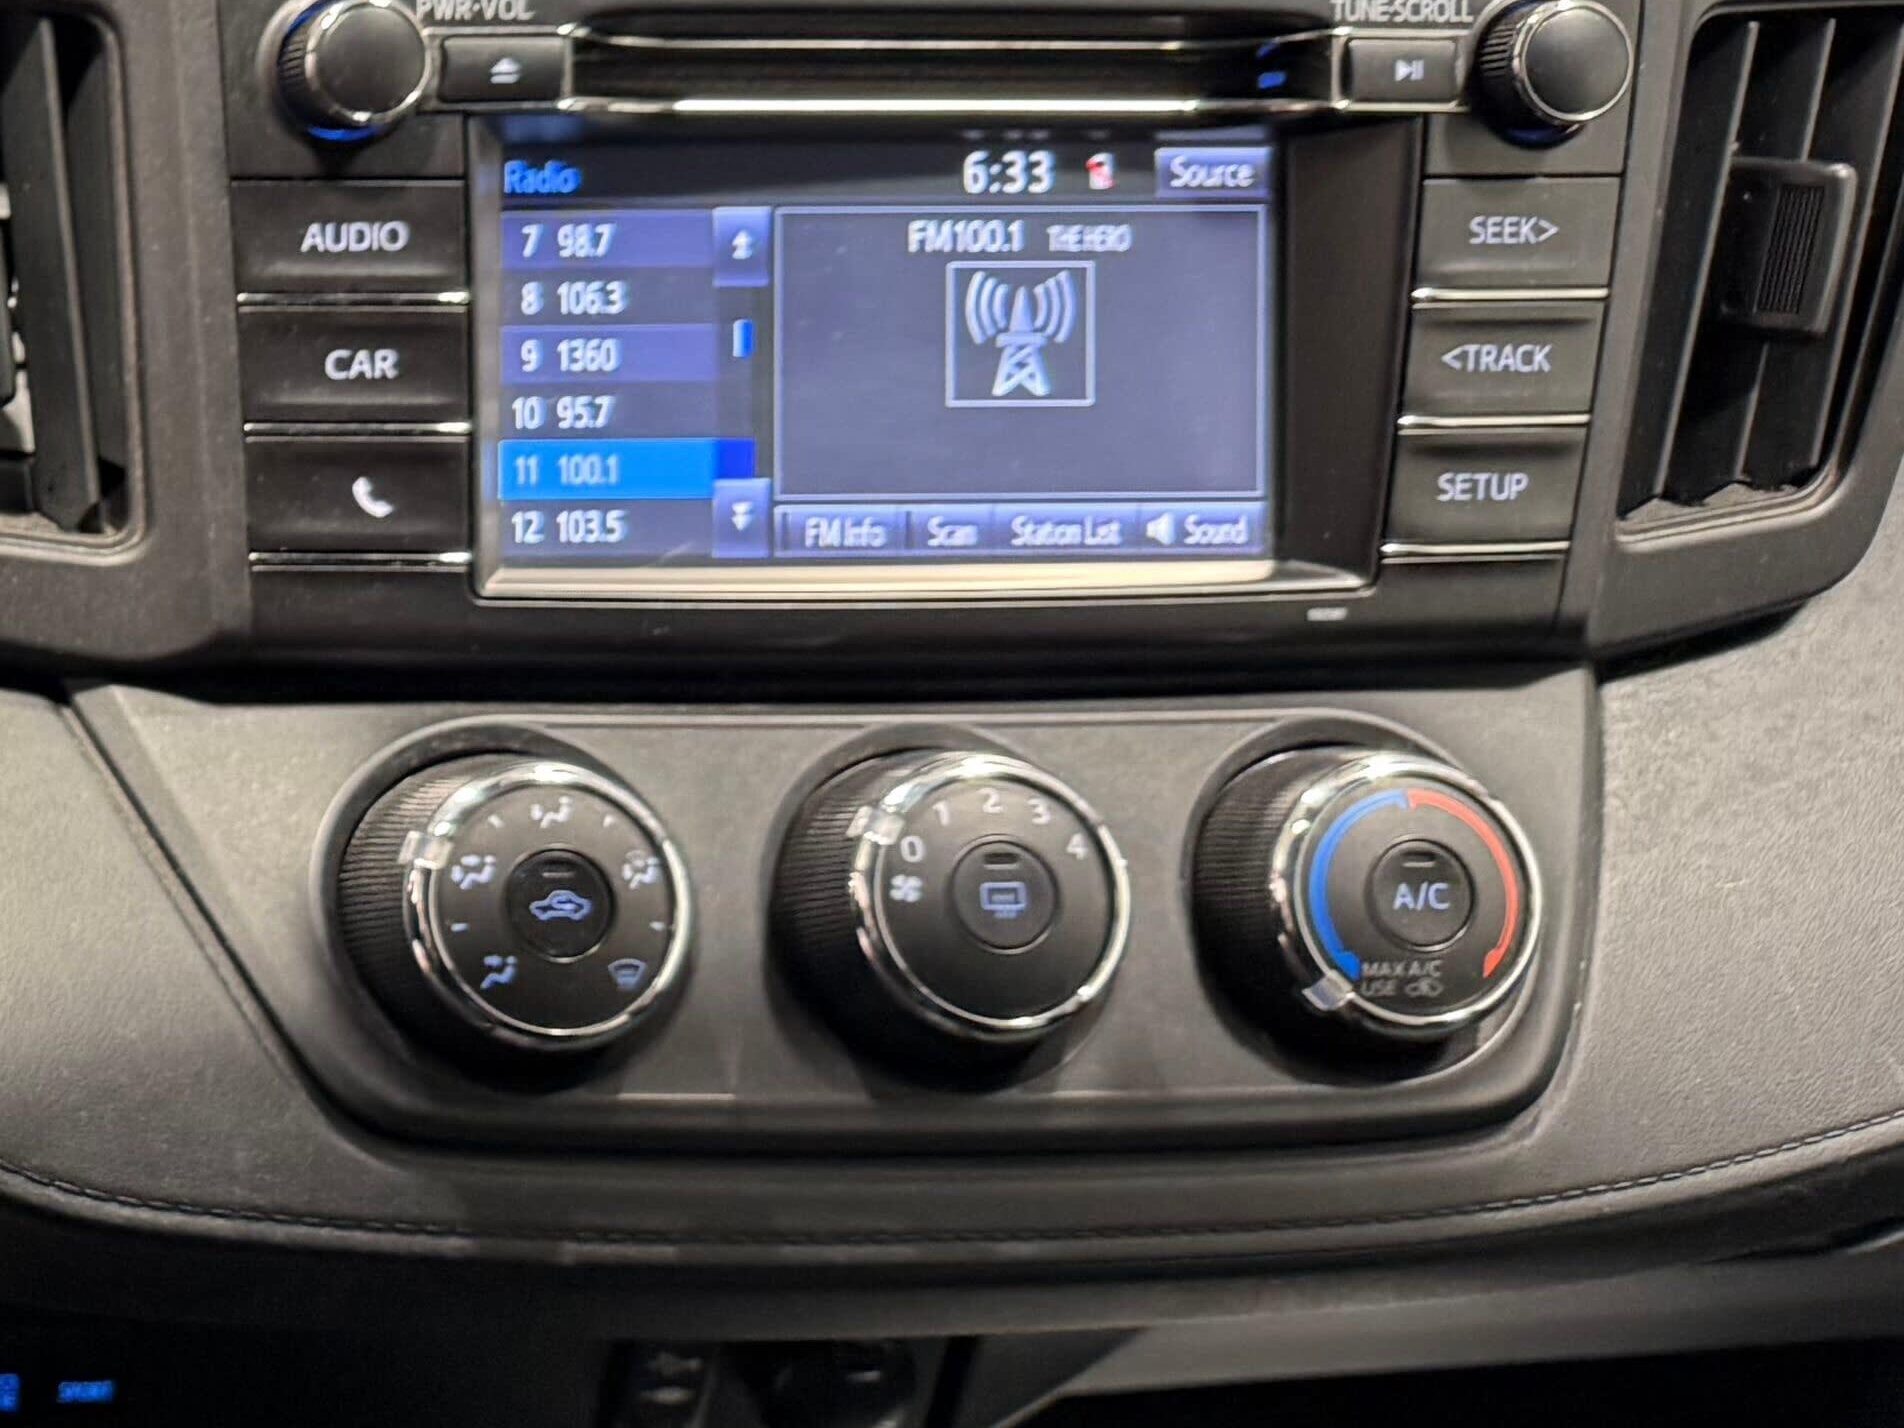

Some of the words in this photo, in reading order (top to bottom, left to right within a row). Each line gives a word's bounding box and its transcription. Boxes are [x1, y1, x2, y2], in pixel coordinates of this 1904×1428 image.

[504, 160, 580, 194] Radio
[962, 150, 1054, 195] 6:33
[1170, 156, 1255, 189] Source
[301, 221, 409, 253] AUDIO
[521, 224, 543, 258] 7
[557, 224, 616, 258] 98.7
[521, 281, 543, 315] 8
[558, 281, 629, 315] 106.3
[325, 349, 399, 380] CAR
[521, 339, 542, 372] 9
[558, 339, 622, 372] 1360
[512, 395, 546, 429] 10
[557, 395, 616, 429] 95.7
[516, 455, 539, 485] 11
[558, 455, 620, 485] 100.1
[1436, 472, 1529, 503] SETUP
[512, 510, 545, 543] 12
[557, 510, 628, 543] 103.5
[933, 800, 950, 826] 1
[981, 788, 1003, 814] 2
[1028, 797, 1051, 824] 3
[900, 835, 925, 863] 0
[1066, 833, 1089, 860] 4
[1393, 881, 1450, 910] A/C
